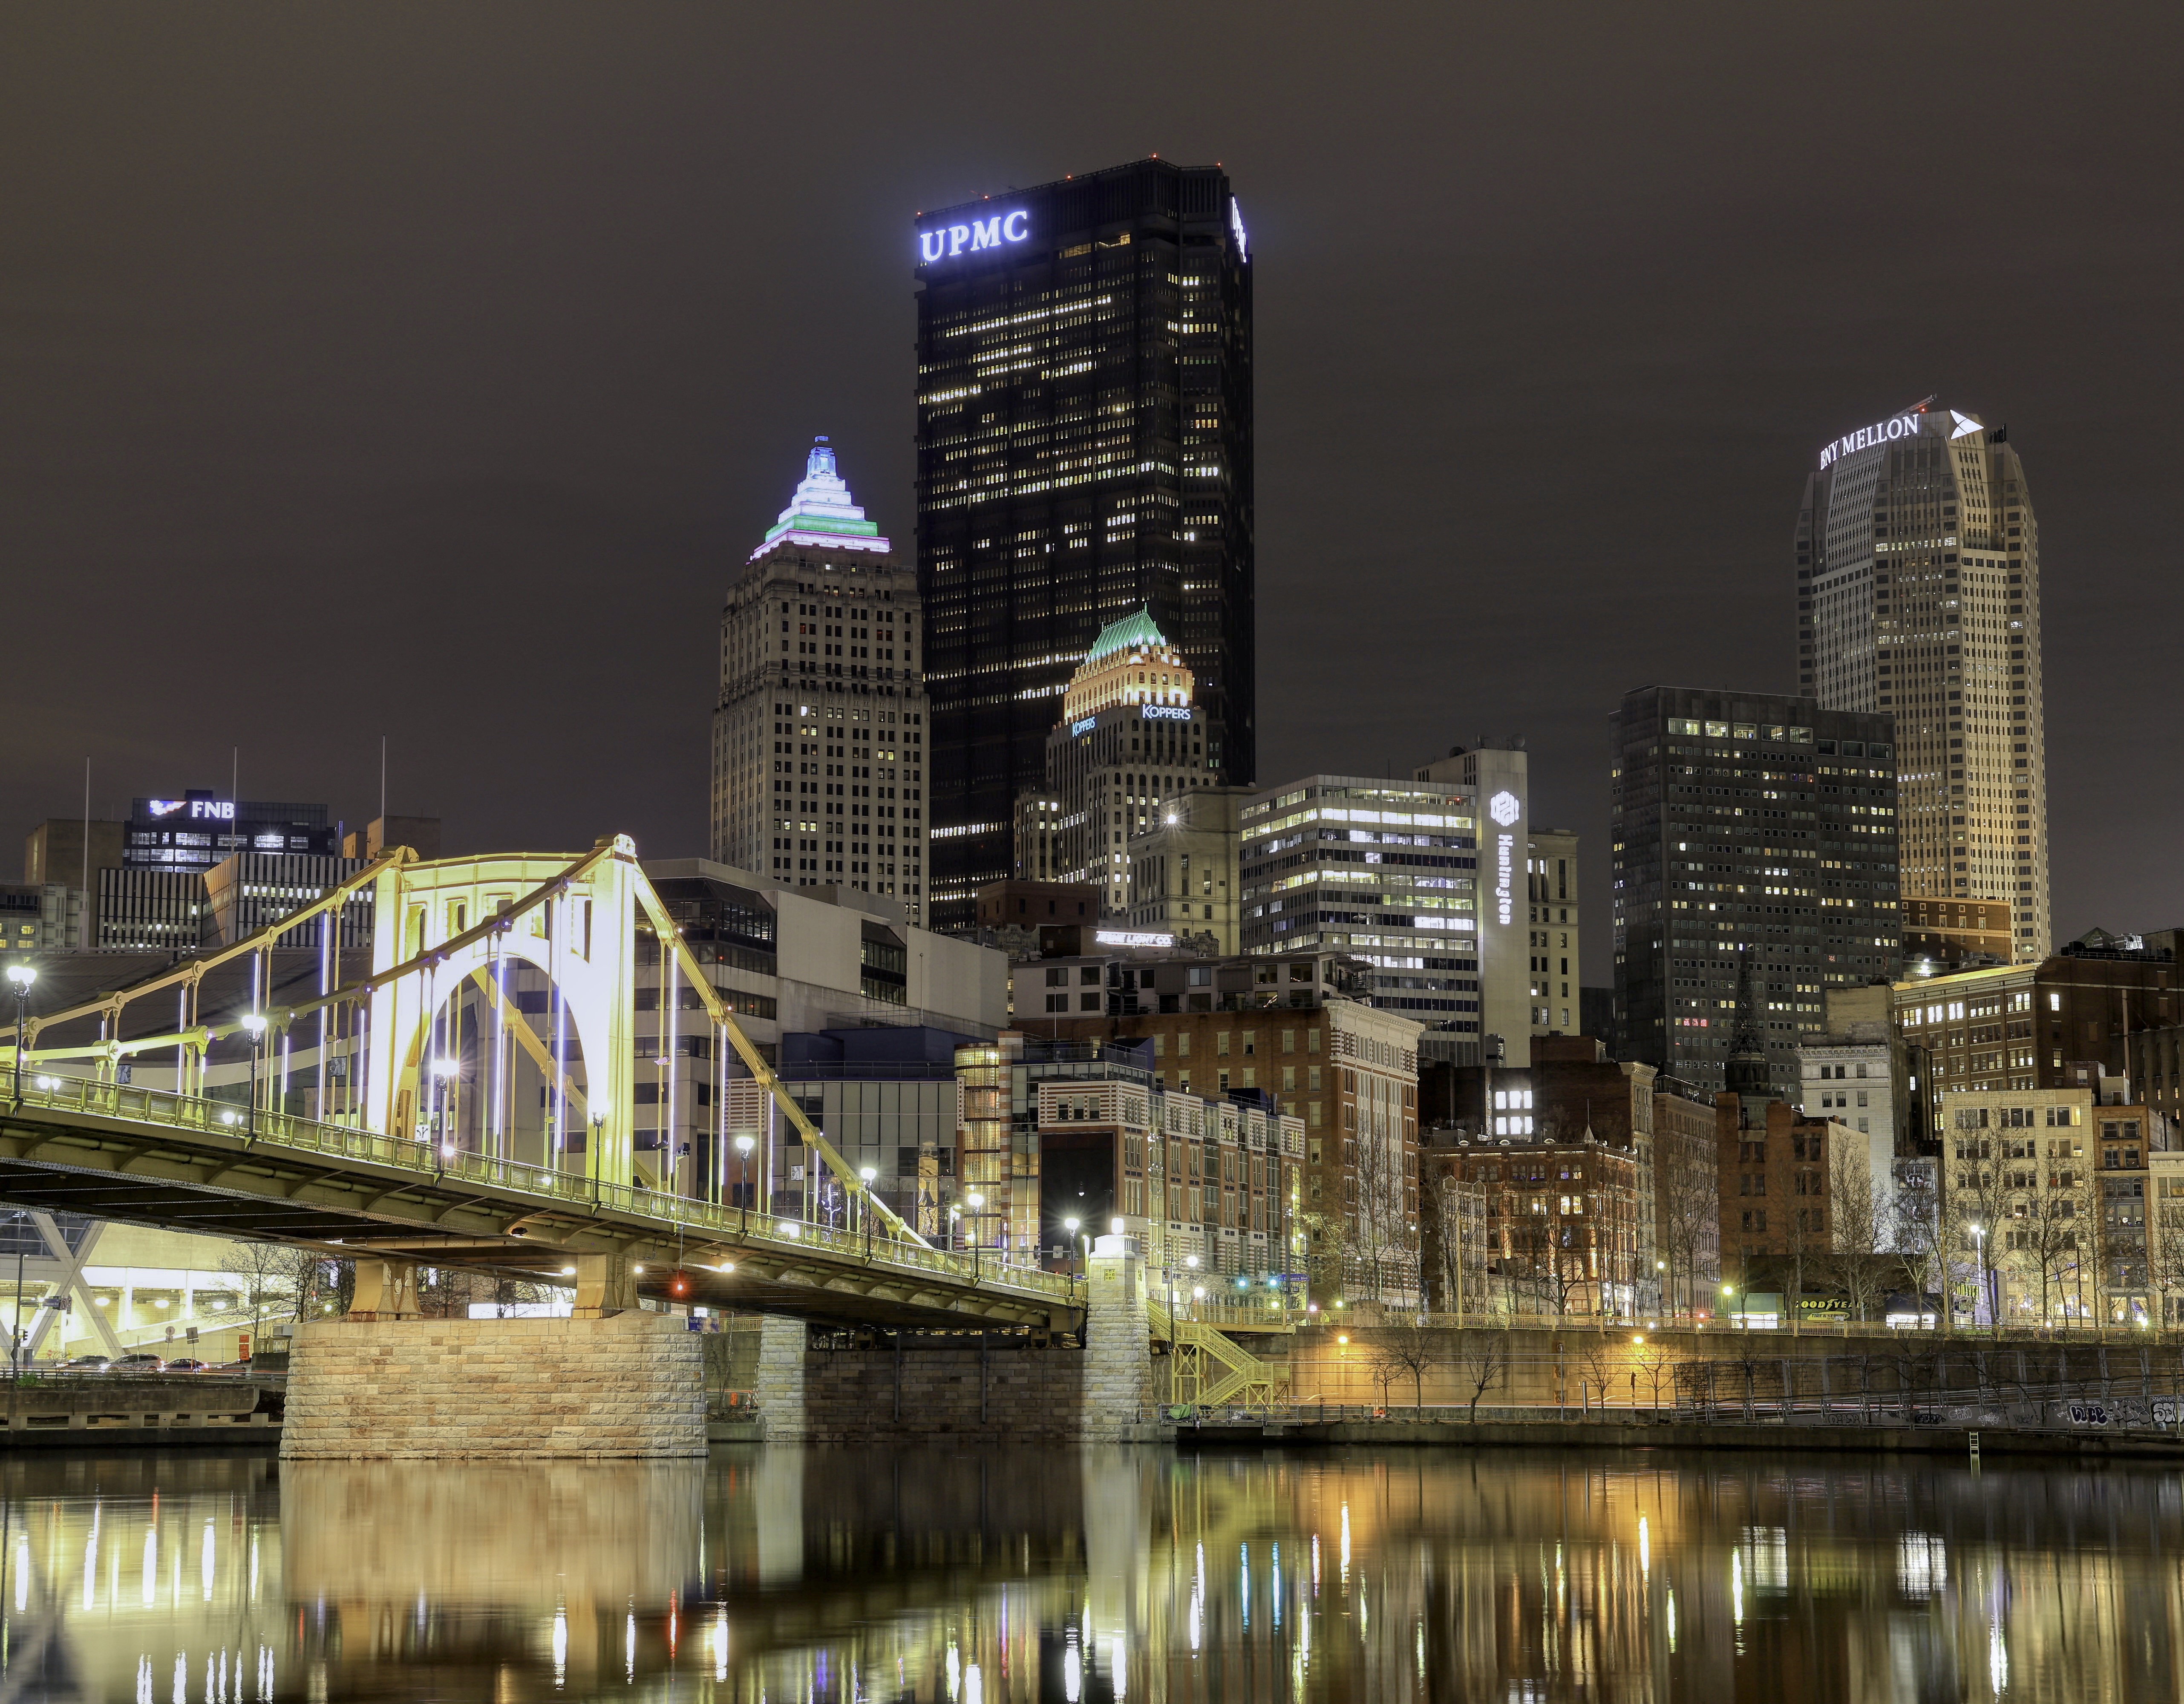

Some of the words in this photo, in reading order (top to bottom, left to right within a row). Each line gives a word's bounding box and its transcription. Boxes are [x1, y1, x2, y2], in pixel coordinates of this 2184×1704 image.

[920, 211, 1027, 261] UPMC
[1820, 440, 1839, 470] BNY
[1842, 414, 1919, 456] MELLON
[1072, 717, 1095, 737] KOPPERS
[1143, 704, 1191, 720] KOPPERS
[192, 801, 234, 818] FNB
[1495, 835, 1513, 924] Huntington
